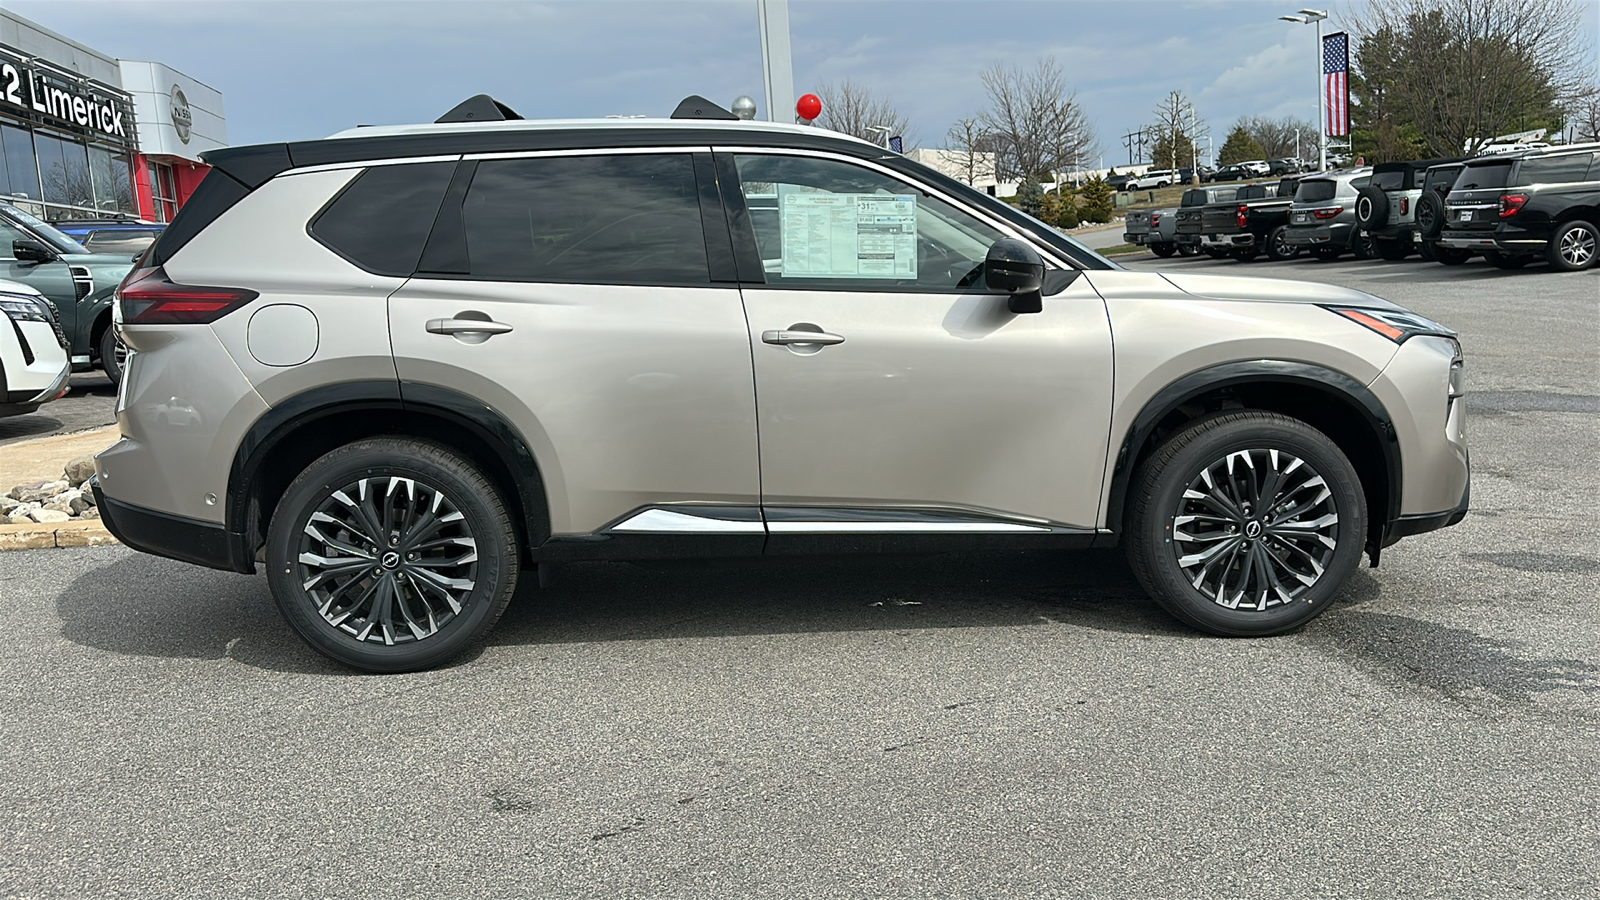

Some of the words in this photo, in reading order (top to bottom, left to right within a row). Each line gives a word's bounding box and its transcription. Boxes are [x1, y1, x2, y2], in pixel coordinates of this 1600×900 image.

[0, 63, 22, 106] 2
[28, 69, 125, 137] Limerick
[861, 202, 870, 210] 31
